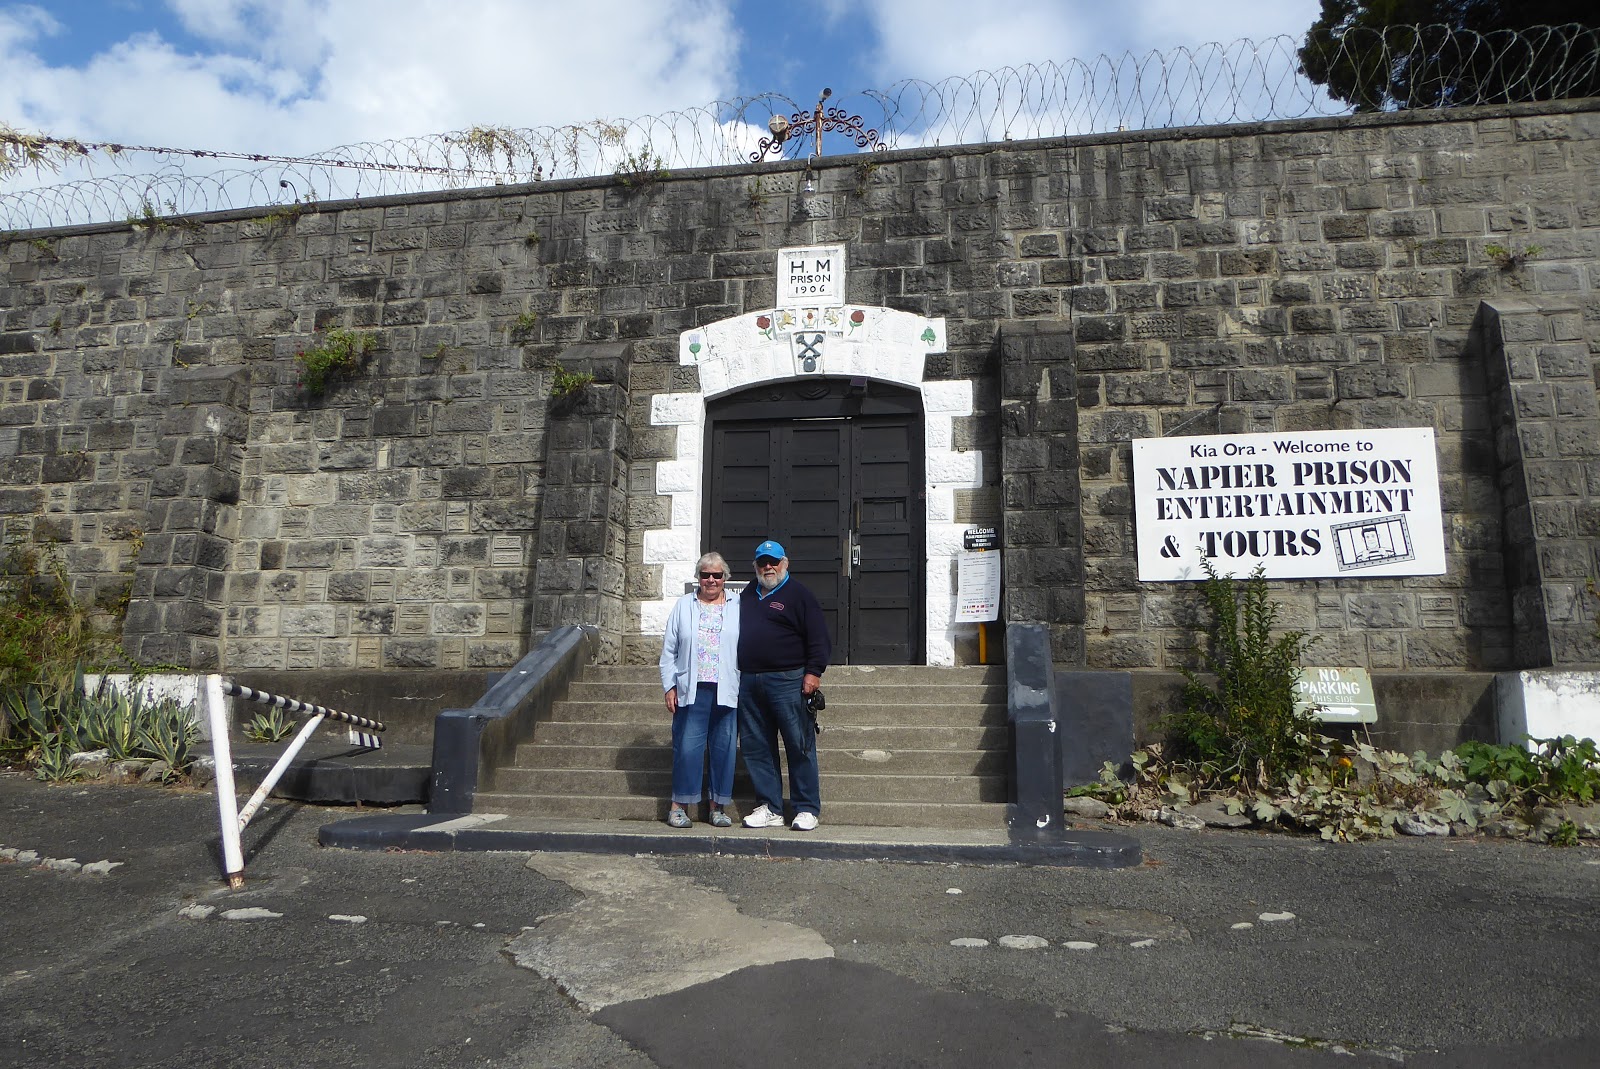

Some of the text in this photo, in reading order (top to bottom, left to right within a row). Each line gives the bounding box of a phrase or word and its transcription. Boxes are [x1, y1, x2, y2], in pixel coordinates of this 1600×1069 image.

[790, 274, 831, 284] PRISON
[795, 285, 825, 294] 1906
[1190, 443, 1218, 458] Kia
[1223, 442, 1256, 456] Ora
[1273, 440, 1350, 455] Welcome
[1356, 440, 1374, 452] to
[1156, 459, 1413, 491] NAPIER PRISON
[1156, 488, 1414, 521] ENTERTAINMENT
[967, 527, 995, 535] WELCOME
[1160, 528, 1322, 559] & TOURS
[1318, 669, 1340, 681] NO
[1300, 681, 1361, 695] PARKING
[1310, 694, 1355, 703] THIS SIDE
